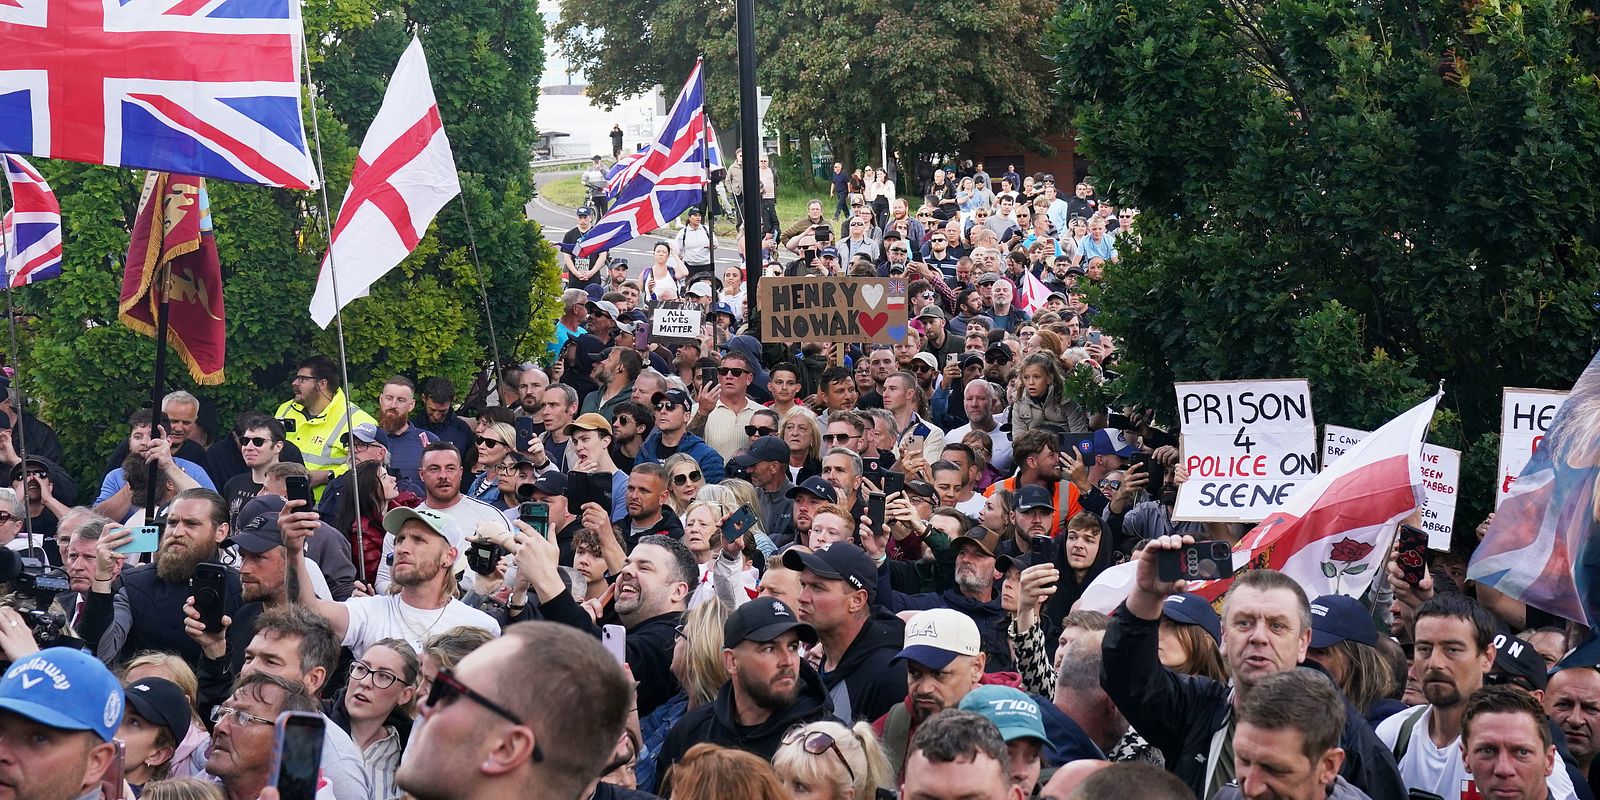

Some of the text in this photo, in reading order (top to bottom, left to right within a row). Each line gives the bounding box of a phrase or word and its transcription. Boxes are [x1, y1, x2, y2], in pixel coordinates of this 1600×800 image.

[772, 282, 858, 312] HENRY
[659, 325, 693, 333] MATTER
[771, 310, 860, 338] NOWAK
[1183, 392, 1306, 424] PRISON
[1233, 426, 1256, 454] 4
[1327, 433, 1336, 442] I
[1187, 452, 1316, 478] POLICE ON
[1198, 482, 1295, 508] SCENE
[1422, 479, 1454, 494] TABBED
[1422, 520, 1451, 534] ABBED
[908, 621, 938, 638] LA
[7, 657, 71, 690] Callaway
[989, 699, 1037, 714] T100
